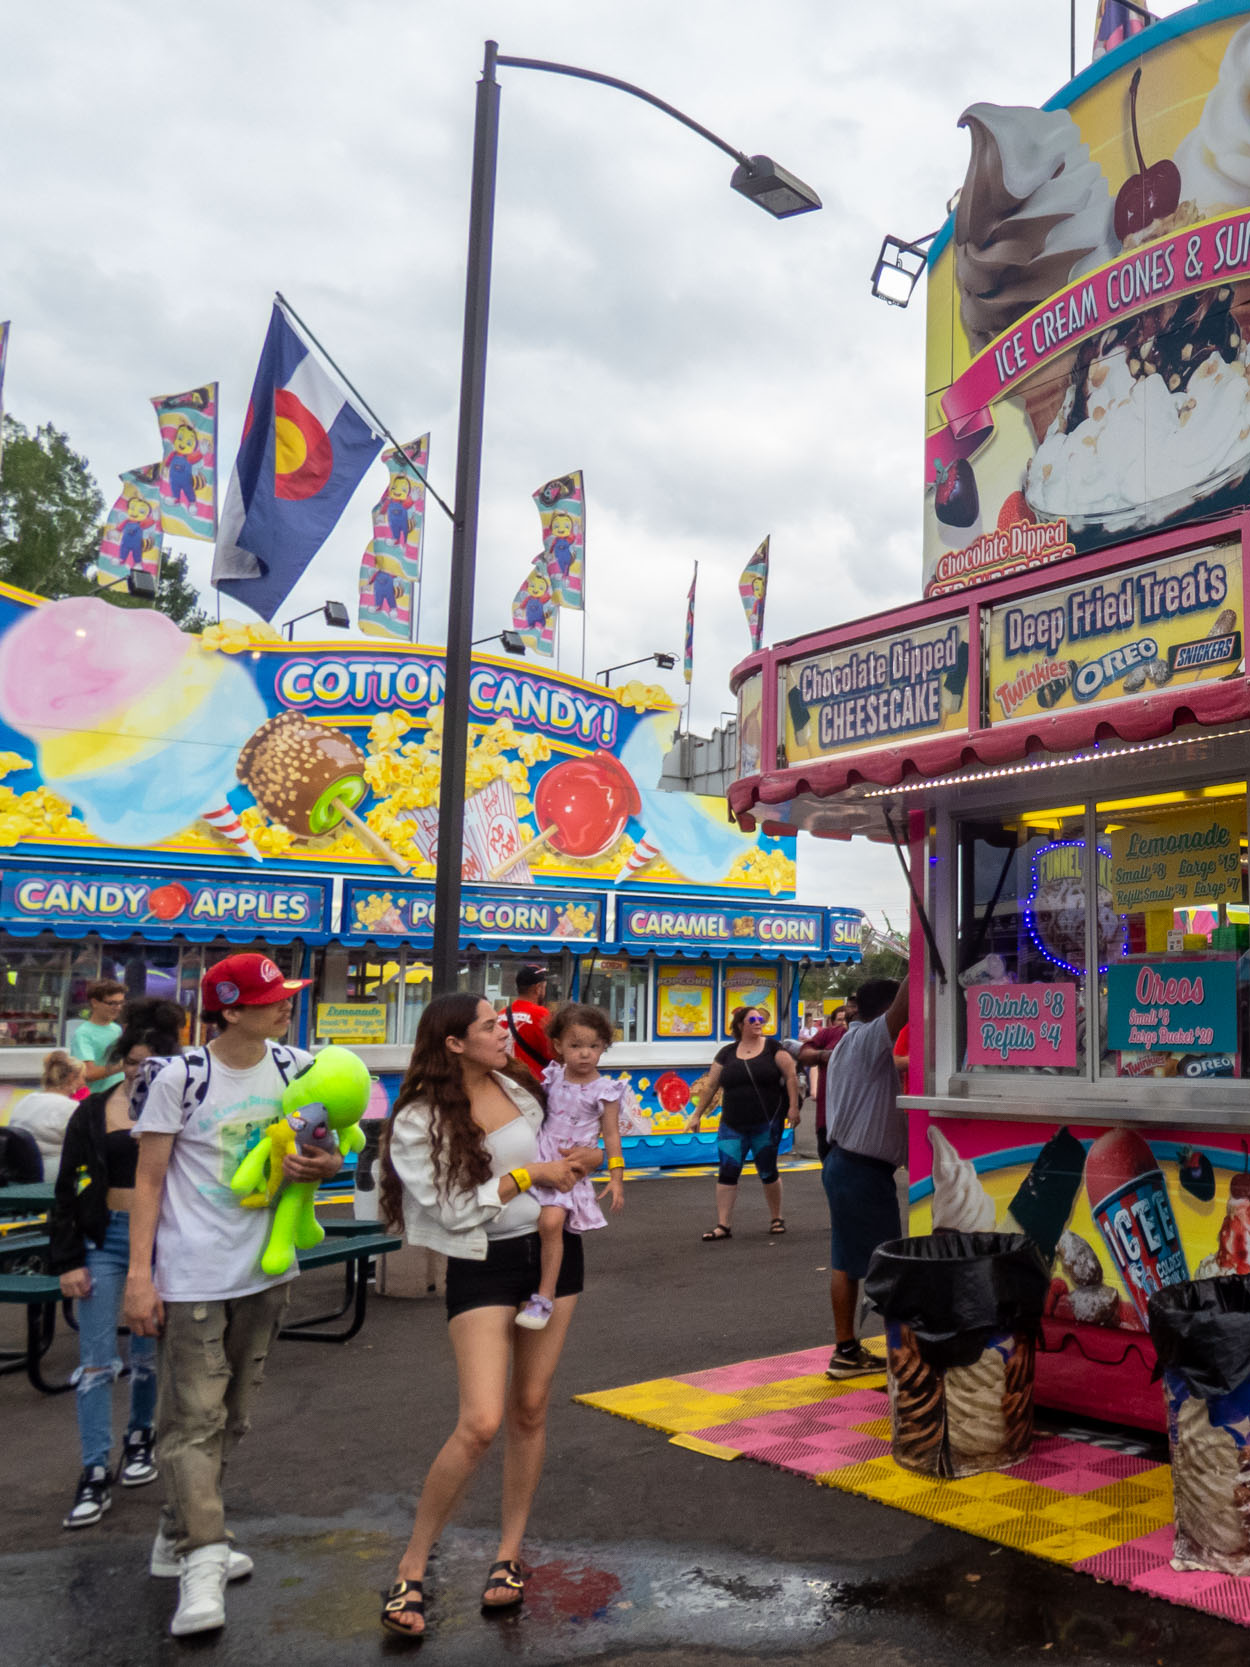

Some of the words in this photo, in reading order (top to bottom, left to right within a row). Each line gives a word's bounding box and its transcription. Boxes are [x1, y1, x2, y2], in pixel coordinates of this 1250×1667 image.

[994, 343, 1027, 383] ICE
[1030, 289, 1099, 354] CREAM
[1107, 243, 1176, 310] CONES
[1185, 235, 1204, 279] &
[937, 534, 1009, 580] Chocolate
[1012, 521, 1065, 555] Dipped
[1008, 609, 1065, 654] Deep
[1072, 579, 1134, 637] Fried
[1139, 562, 1228, 618] Treats
[801, 652, 888, 702] Chocolate
[890, 629, 957, 685] Dipped
[995, 660, 1070, 716] Twinkies
[1074, 640, 1157, 697] OREO
[1176, 637, 1234, 668] SNICKERS
[281, 662, 447, 703] COTTON
[469, 671, 616, 743] CANDY!
[820, 681, 940, 745] CHEESECAKE
[1126, 822, 1231, 860] Lemonade
[1116, 864, 1152, 885] Small
[1178, 858, 1218, 881] Large
[1218, 852, 1239, 873] $15
[18, 881, 148, 917] CANDY
[190, 889, 308, 922] APPLES
[1194, 880, 1227, 901] Large
[479, 904, 547, 930] CORN
[629, 911, 729, 939] CARAMEL
[758, 918, 816, 944] CORN
[978, 991, 1039, 1018] Drinks
[1044, 989, 1065, 1018] $8
[1136, 966, 1204, 1006] Oreos
[1129, 1007, 1158, 1026] Small
[981, 1021, 1036, 1060] Refills
[1040, 1021, 1062, 1050] $4
[1128, 1026, 1157, 1050] Large
[1158, 1026, 1195, 1045] Bucket
[1185, 1056, 1232, 1078] OREO
[1102, 1190, 1176, 1268] ICEE
